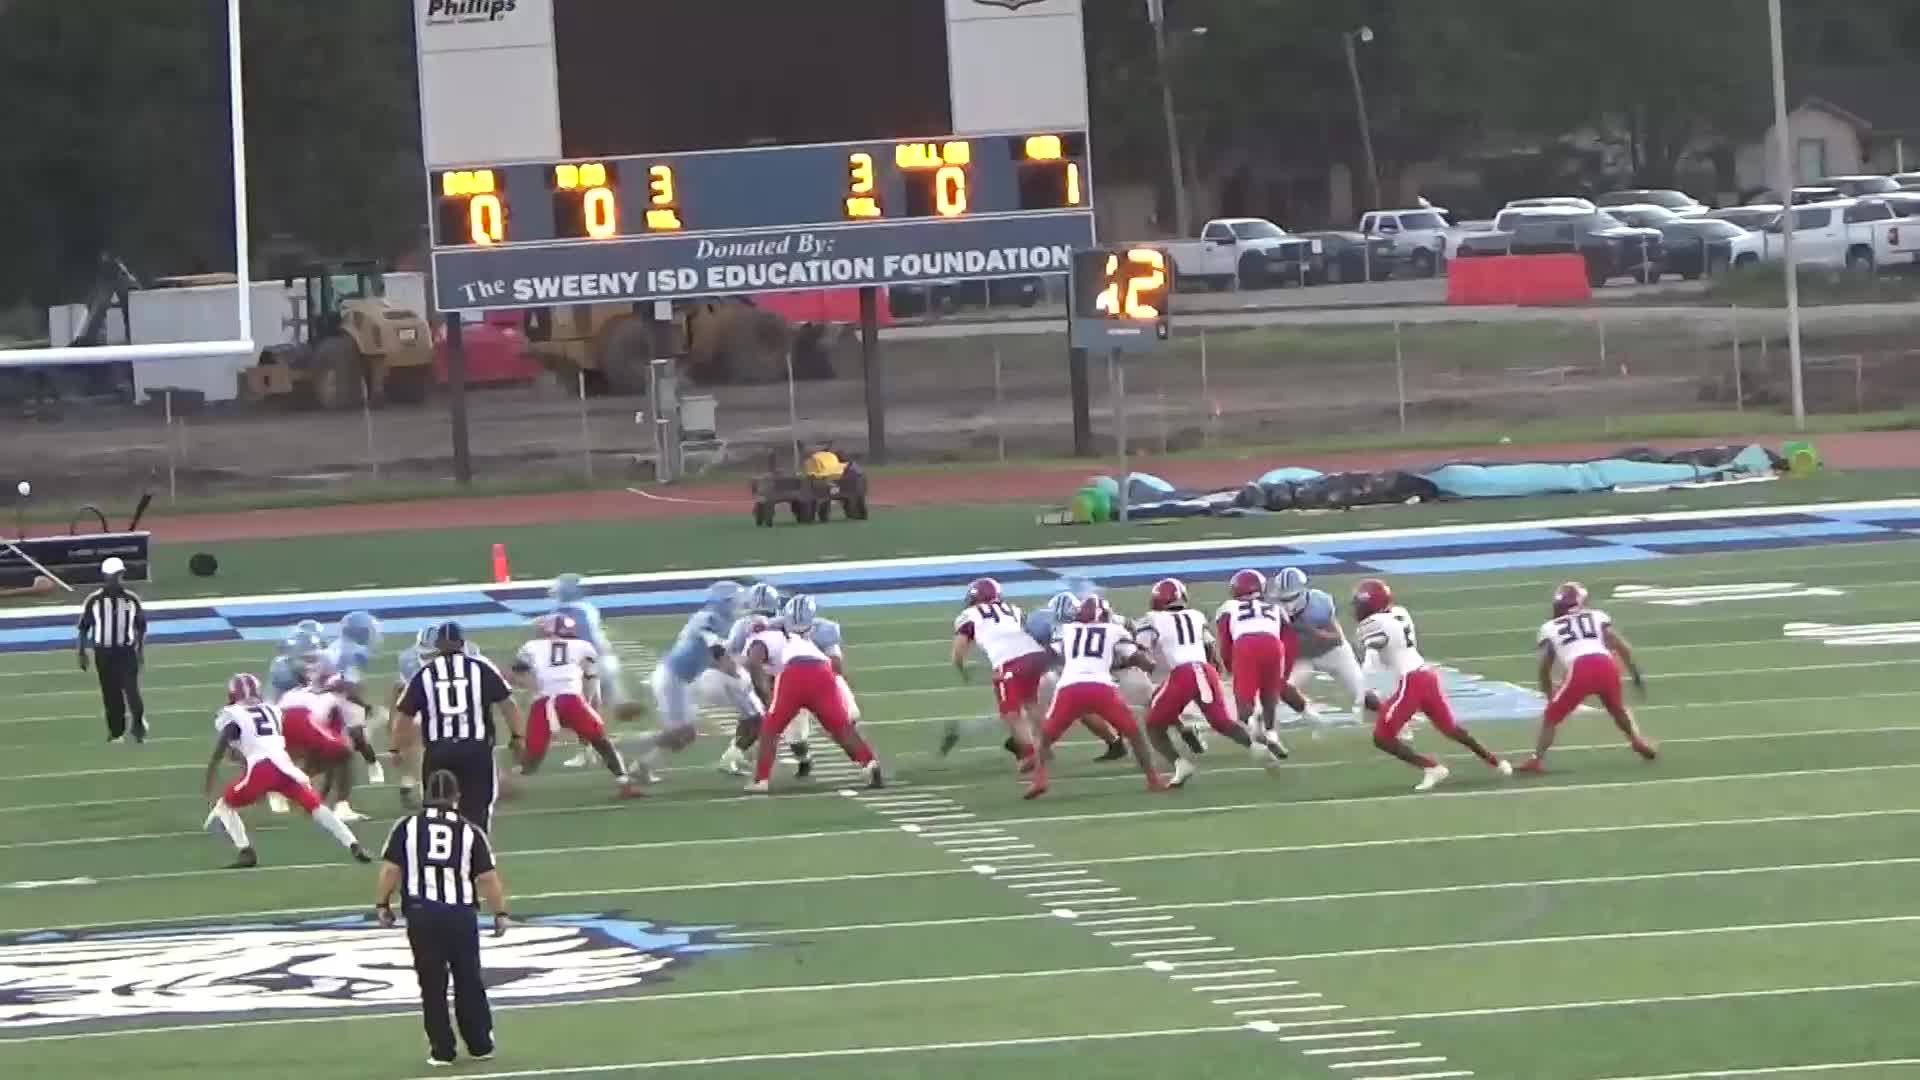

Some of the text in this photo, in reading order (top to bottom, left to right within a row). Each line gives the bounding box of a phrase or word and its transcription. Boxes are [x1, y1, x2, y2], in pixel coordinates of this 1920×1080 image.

[650, 165, 672, 204] 3
[850, 153, 873, 192] 3
[936, 166, 966, 217] 0
[1067, 163, 1080, 204] 1
[470, 194, 502, 245] 0
[584, 187, 615, 238] 0
[696, 234, 836, 259] Donated By:
[459, 244, 1072, 303] The SWEENY ISD EDUCATION FOUNDATION
[1071, 626, 1107, 659] 10
[1174, 613, 1196, 646] 11
[1557, 612, 1598, 646] 30
[435, 679, 469, 715] U
[427, 823, 453, 861] B
